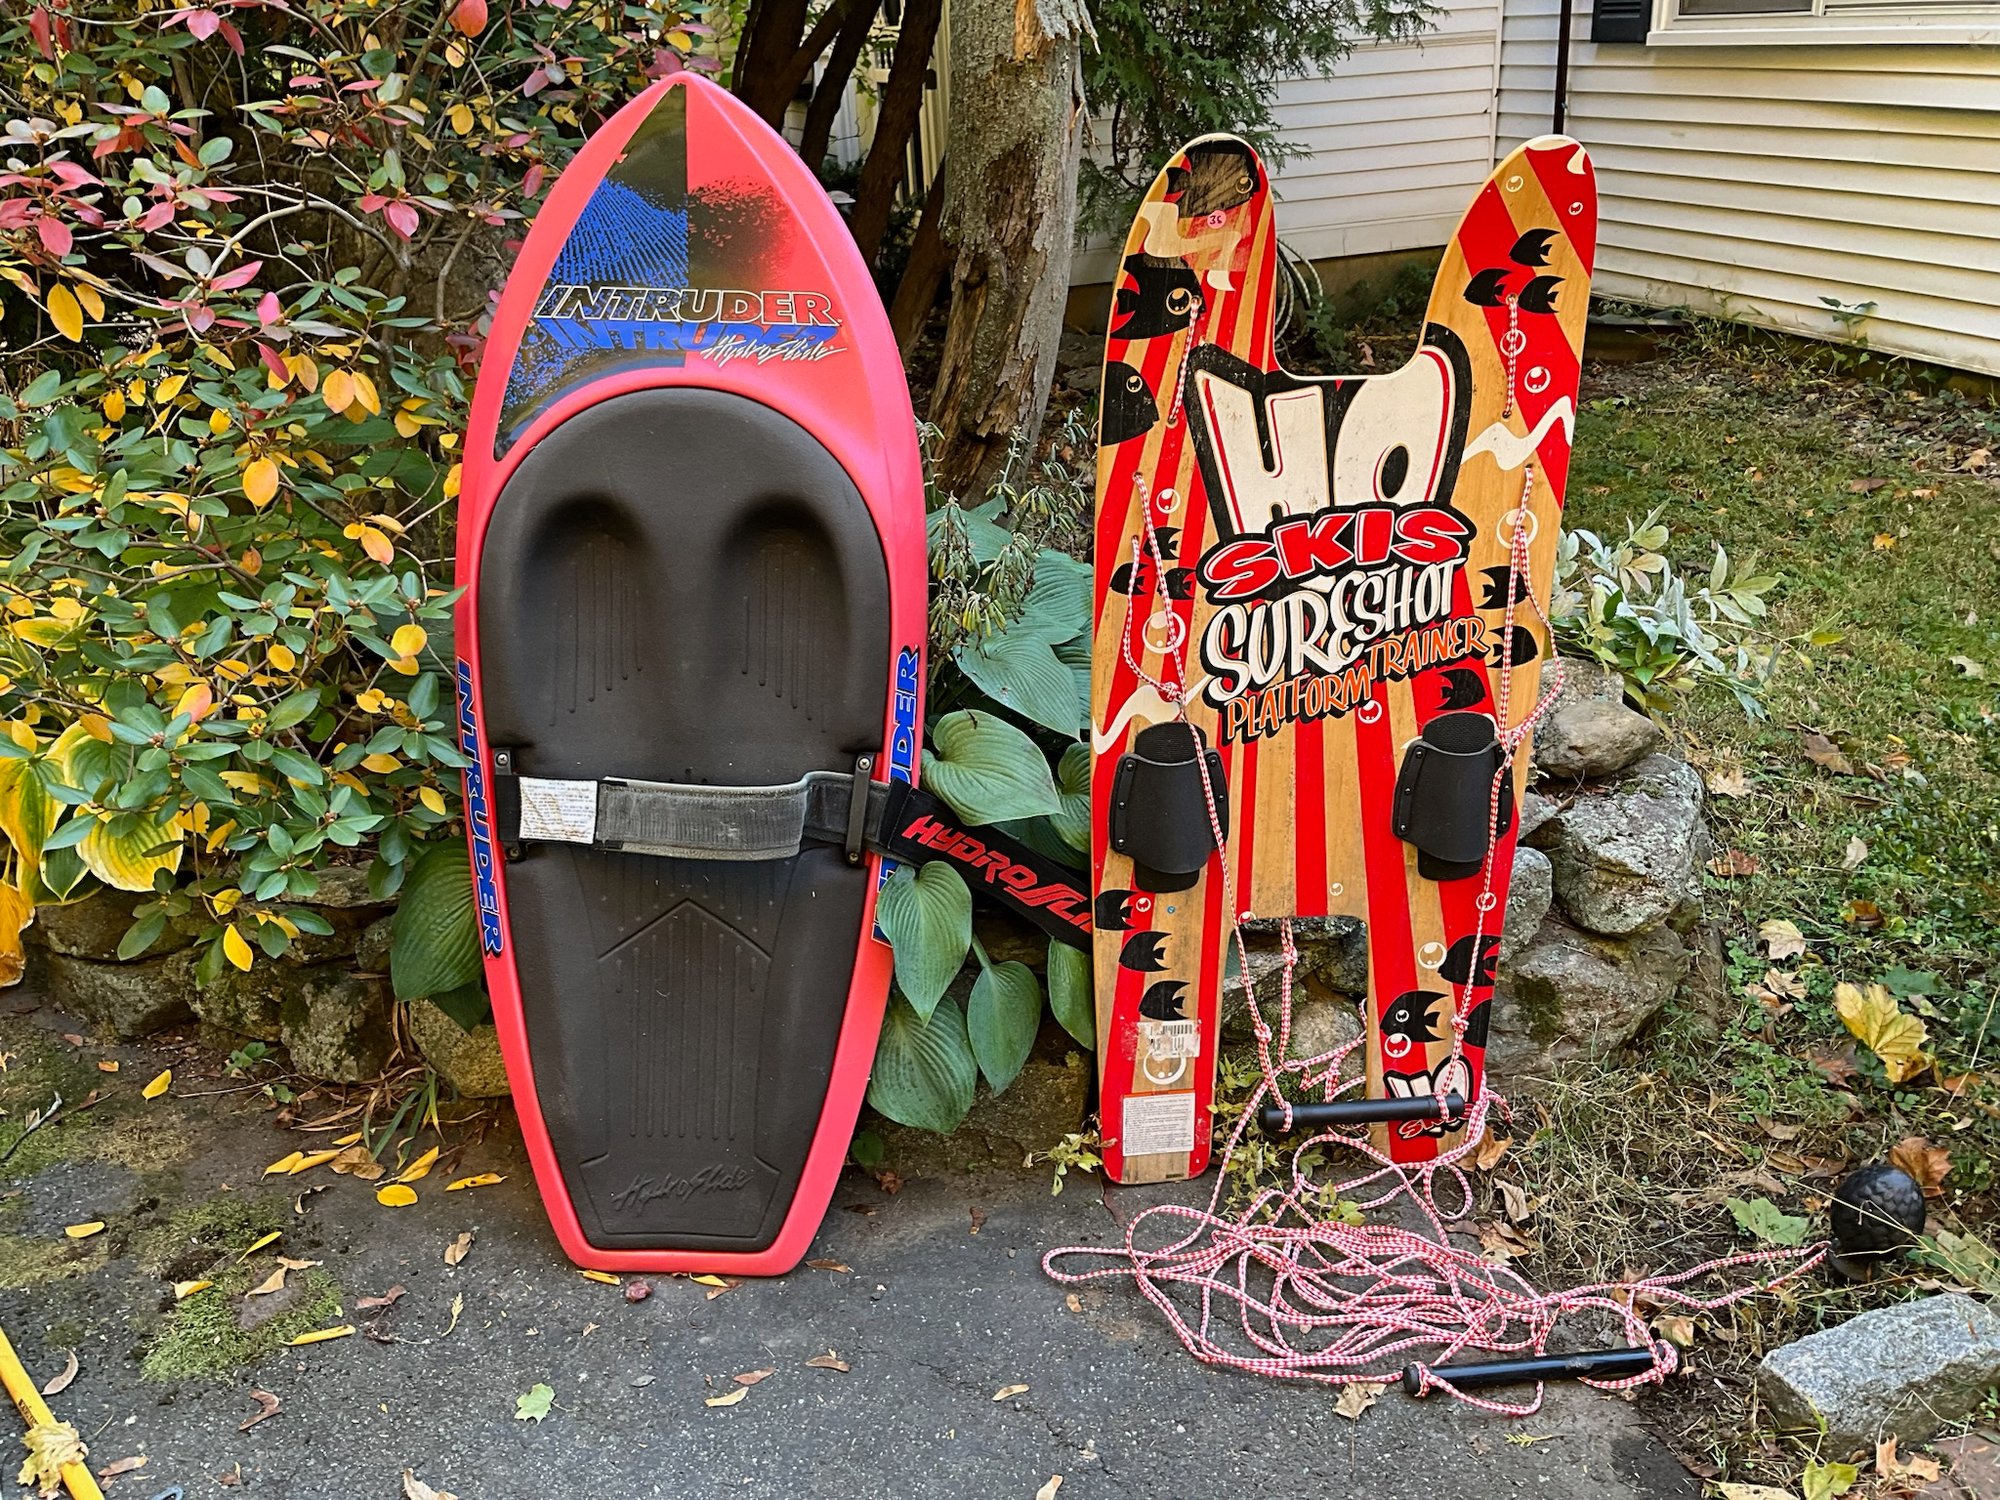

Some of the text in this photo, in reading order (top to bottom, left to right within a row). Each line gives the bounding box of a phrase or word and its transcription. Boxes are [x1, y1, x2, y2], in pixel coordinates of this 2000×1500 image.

[534, 284, 838, 327] INTRUDER
[1194, 344, 1457, 535] HO
[1202, 508, 1470, 599] SKIS
[1206, 557, 1468, 702] SURESHOT
[1226, 616, 1490, 741] PLATFORM TRAINER
[457, 655, 504, 955] INTRUDER
